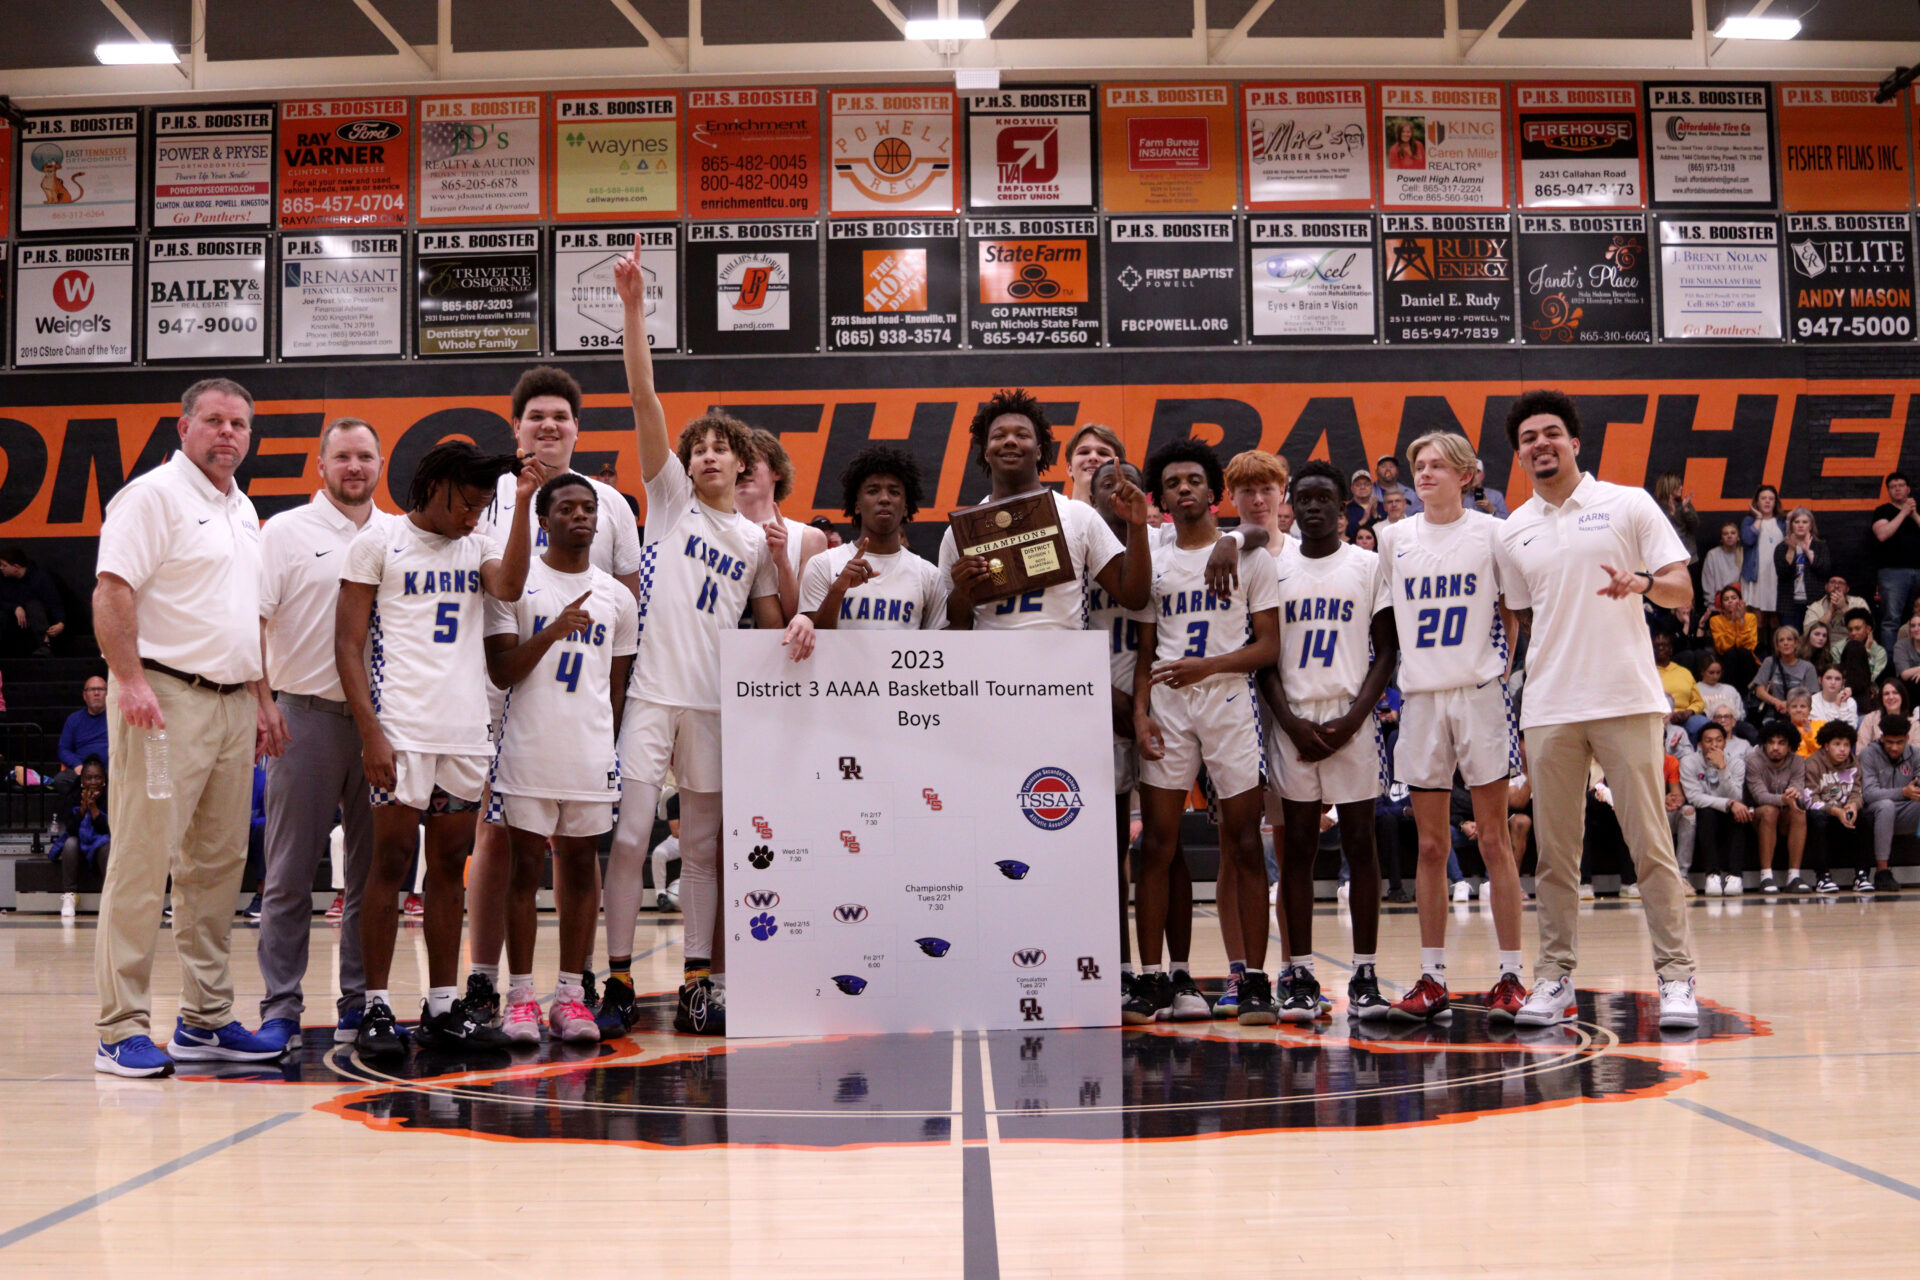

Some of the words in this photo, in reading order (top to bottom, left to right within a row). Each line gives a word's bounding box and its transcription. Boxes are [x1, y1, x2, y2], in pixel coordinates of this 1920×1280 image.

[837, 97, 878, 112] P.H.S.
[884, 96, 950, 111] BOOSTER
[1112, 90, 1153, 104] P.H.S.
[1158, 89, 1224, 103] BOOSTER
[1387, 90, 1427, 104] P.H.S.
[1432, 91, 1498, 105] BOOSTER
[1655, 91, 1695, 105] P.H.S.
[1700, 91, 1763, 105] BOOSTER
[286, 103, 327, 117] P.H.S.
[331, 101, 404, 116] BOOSTER
[562, 102, 603, 117] P.H.S.
[607, 100, 673, 115] BOOSTER
[27, 120, 66, 134] P.H.S.
[71, 117, 134, 132] BOOSTER
[706, 119, 809, 131] Enrichment
[996, 118, 1059, 126] KNOXVILLE
[1449, 121, 1495, 135] KING
[1678, 122, 1721, 132] Affordable
[1723, 122, 1739, 132] Tire
[1528, 122, 1629, 142] FIREHOUSE
[297, 133, 331, 147] RAY
[588, 138, 669, 157] waynes
[1139, 138, 1164, 147] Farm
[1168, 138, 1199, 147] Bureau
[1561, 136, 1598, 147] SUBS
[159, 147, 210, 161] POWER
[213, 147, 223, 159] &
[226, 145, 269, 159] PRYSE
[284, 146, 385, 167] VARNER
[1139, 148, 1199, 158] INSURANCE
[1267, 153, 1310, 161] BARBER
[1316, 152, 1346, 160] SHOP
[335, 166, 385, 175] TENNESSEE
[701, 154, 808, 172] 865-482-0045
[1397, 174, 1427, 183] Powell
[1429, 175, 1451, 185] High
[1453, 175, 1484, 184] Alumni
[1540, 171, 1560, 179] 2431
[1563, 171, 1601, 179] Callahan
[1604, 170, 1627, 178] Road
[441, 178, 518, 190] 865-205-6878
[700, 174, 809, 191] 800-482-0049
[156, 200, 180, 209] CLINTON
[183, 199, 196, 209] OAK
[196, 199, 212, 208] RIDGE
[215, 199, 237, 208] POWELL
[241, 198, 269, 207] KINGSTON
[283, 193, 404, 213] 865-457-0704
[586, 195, 648, 204] callwaynes.com
[701, 196, 809, 211] enrichmentfcu.org
[173, 212, 191, 224] Go
[193, 210, 252, 223] Panthers!
[692, 226, 733, 239] P.H.S.
[737, 224, 813, 238] BOOSTER
[973, 222, 1015, 236] P.H.S.
[1020, 221, 1095, 235] BOOSTER
[1256, 224, 1297, 238] P.H.S.
[1302, 223, 1368, 238] BOOSTER
[1525, 219, 1566, 232] P.H.S.
[1570, 218, 1643, 232] BOOSTER
[154, 243, 192, 257] P.H.S.
[197, 241, 262, 256] BOOSTER
[1437, 238, 1508, 258] RUDY
[1830, 241, 1905, 263] ELITE
[303, 268, 398, 285] RENASANT
[452, 266, 531, 279] TRIVETTE
[1146, 269, 1178, 279] FIRST
[1183, 268, 1234, 279] BAPTIST
[1438, 262, 1508, 277] ENERGY
[461, 276, 532, 289] OSBORNE
[1528, 264, 1583, 295] Janet's
[1588, 264, 1639, 288] Place
[151, 279, 248, 302] BAILEY
[248, 279, 260, 291] &
[248, 292, 262, 301] CO.
[302, 286, 354, 296] FINANCIAL
[357, 286, 398, 294] SERVICES
[442, 299, 513, 313] 865-687-3203
[1268, 301, 1289, 311] Eyes
[1299, 300, 1322, 310] Brain
[1332, 300, 1359, 310] Vision
[1401, 293, 1444, 307] Daniel
[1449, 294, 1462, 306] E.
[1466, 294, 1501, 310] Rudy
[1798, 289, 1845, 309] ANDY
[1850, 289, 1911, 309] MASON
[832, 315, 849, 326] 2751
[878, 315, 900, 325] Road
[946, 314, 957, 323] TN
[991, 307, 1010, 318] GO
[1013, 307, 1078, 317] PANTHERS!
[35, 314, 112, 337] Weigel's
[158, 317, 258, 335] 947-9000
[733, 321, 775, 331] pandj.com
[971, 320, 998, 331] Ryan
[1000, 319, 1039, 330] Nichols
[1042, 319, 1069, 329] State
[1072, 319, 1099, 328] Farm
[1121, 318, 1229, 332] FBCPOWELL.ORG
[1798, 317, 1911, 337] 947-5000
[427, 328, 480, 341] Dentistry
[483, 328, 500, 338] for
[502, 327, 530, 338] Your
[836, 330, 875, 347] (865)
[880, 328, 952, 345] 938-3574
[983, 331, 1088, 345] 865-947-6560
[1402, 327, 1499, 340] 865-947-7839
[1580, 331, 1650, 342] 865-310-6605
[438, 340, 476, 350] Whole
[479, 338, 518, 350] Family
[1578, 512, 1610, 525] KARNS
[976, 529, 1047, 554] CHAMPIONS
[683, 534, 746, 582] KARNS
[404, 569, 481, 596] KARNS
[1404, 572, 1477, 599] KARNS
[695, 577, 719, 614] 11
[1161, 586, 1232, 617] KARNS
[841, 596, 915, 625] KARNS
[1284, 596, 1354, 623] KARNS
[433, 601, 460, 643] 5
[1415, 605, 1468, 648] 20
[1184, 620, 1210, 658] 3
[1298, 628, 1339, 668] 14
[891, 650, 945, 669] 2023
[556, 651, 584, 693] 4
[736, 680, 801, 698] District
[809, 681, 820, 697] 3
[826, 680, 881, 697] AAAA
[888, 679, 979, 697] Basketball
[986, 680, 1094, 697] Tournament
[898, 711, 941, 730] Boys
[1017, 793, 1085, 808] TSSAA
[732, 829, 738, 838] 4
[733, 862, 739, 871] 5
[905, 884, 964, 894] Championship
[918, 894, 935, 902] Tues
[936, 894, 951, 902] 2/21
[928, 903, 944, 911] 7:30
[734, 933, 740, 942] 6
[815, 989, 821, 997] 2
